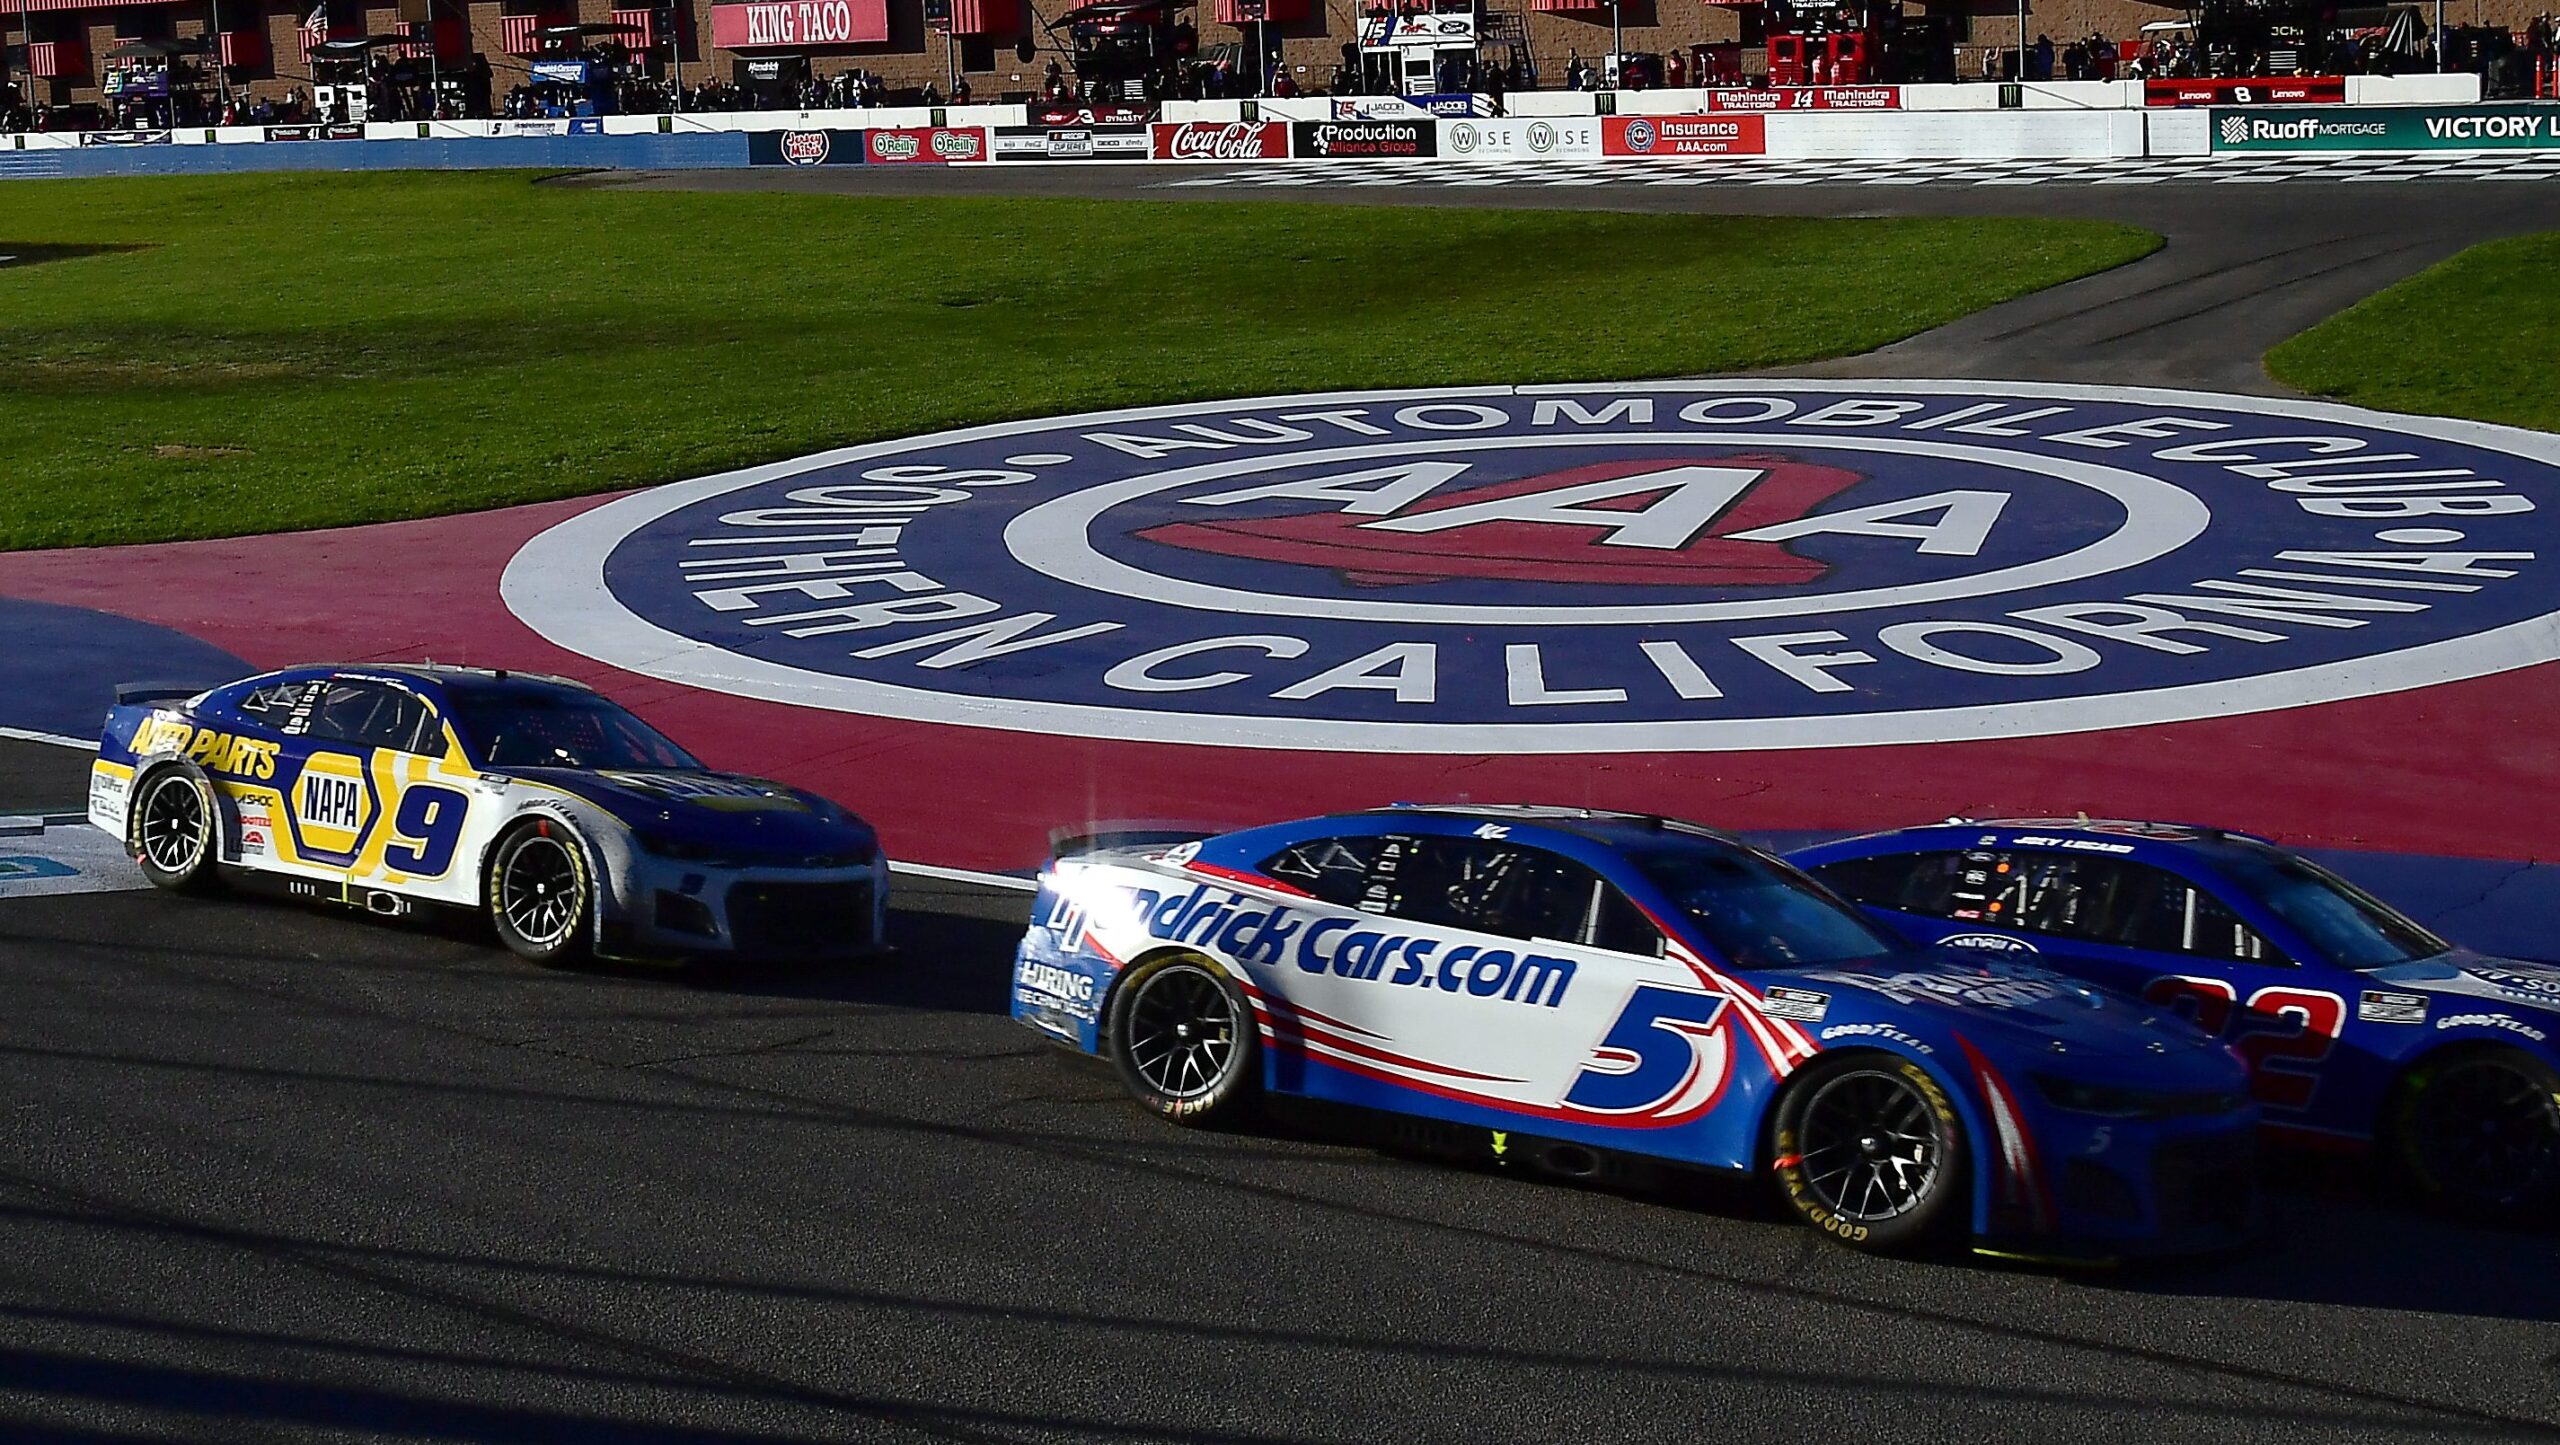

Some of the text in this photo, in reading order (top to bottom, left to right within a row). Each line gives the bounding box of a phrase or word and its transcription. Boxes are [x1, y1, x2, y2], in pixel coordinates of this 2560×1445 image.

[747, 1, 851, 43] KING TACO
[1443, 24, 1466, 32] Ford
[1367, 23, 1386, 37] 15
[1717, 91, 1781, 101] Mahindra
[1791, 90, 1814, 108] 14
[1823, 90, 1890, 100] Mahindra
[2179, 91, 2212, 100] Lenovo
[2234, 87, 2252, 102] 8
[2271, 89, 2305, 98] Lenovo
[1371, 103, 1405, 111] JACOB
[1432, 101, 1468, 110] JACOB
[1722, 101, 1777, 109] TRACTORS
[1829, 99, 1885, 107] TRACTORS
[1078, 109, 1095, 124] 3
[1105, 114, 1143, 122] DYNASTY
[307, 127, 320, 140] 41
[491, 122, 502, 135] 5
[1326, 124, 1417, 140] Production
[1661, 120, 1738, 136] Insurance
[2252, 119, 2386, 140] Ruoff MORTGAGE
[2424, 117, 2543, 138] VICTORY
[787, 132, 823, 147] Jersey
[875, 132, 917, 155] O'Reilly
[934, 131, 977, 154] O'Reilly
[1171, 121, 1262, 159] Coca-Cola
[1456, 131, 1511, 145] WISE
[1533, 130, 1589, 145] WISE
[1328, 140, 1417, 155] Alliance Group
[1676, 141, 1727, 152] AAA.com
[1081, 397, 2536, 519] AUTOMOBILE CLUB
[1178, 461, 2012, 556] AAA
[678, 465, 1127, 669] SOUTHERN
[1103, 550, 2535, 706] CALIFORNIA
[187, 728, 282, 780] PARTS
[304, 775, 359, 829] NAPA
[382, 780, 472, 883] 9
[1019, 960, 1095, 1001] HIRING
[1820, 1022, 1934, 1055] GOODYEAR
[1560, 979, 1732, 1120] 5
